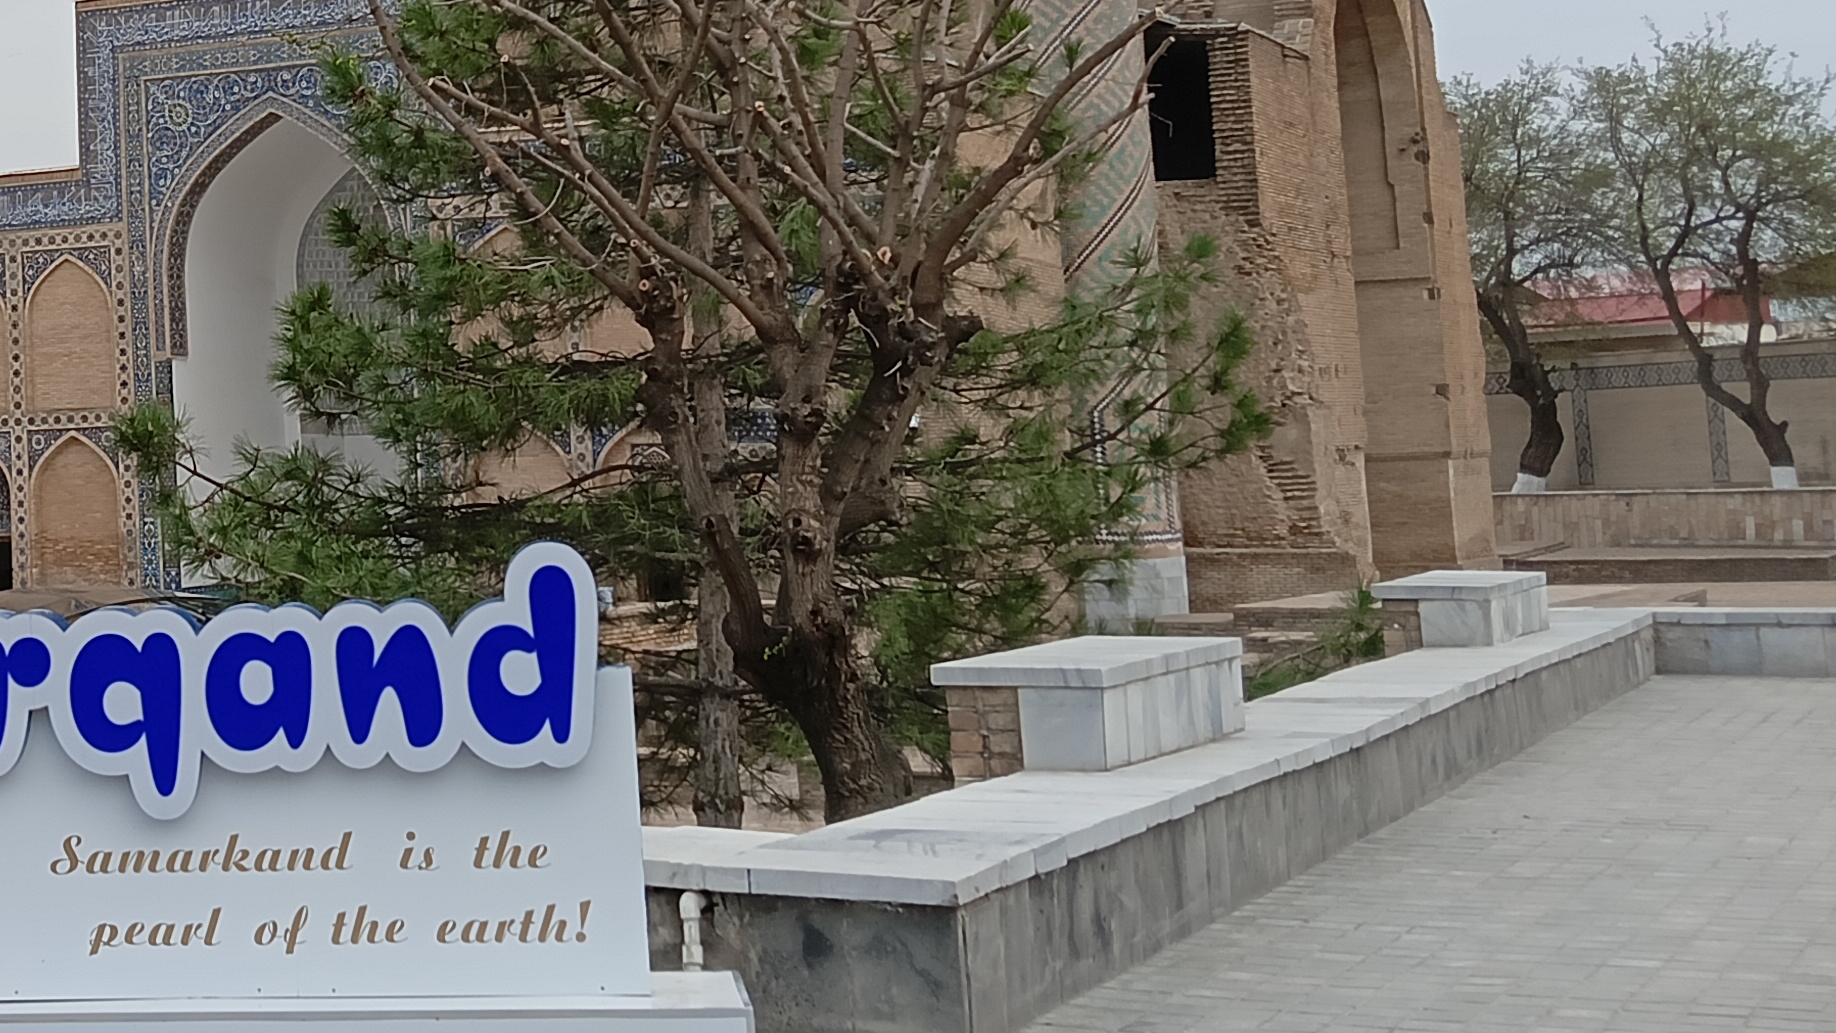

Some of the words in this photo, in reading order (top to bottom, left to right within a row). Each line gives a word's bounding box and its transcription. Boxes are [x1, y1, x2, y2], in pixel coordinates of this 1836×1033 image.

[50, 830, 353, 875] Samarkand
[399, 831, 439, 871] is
[473, 830, 550, 870] the
[89, 908, 222, 956] pearl
[253, 907, 310, 955] of
[331, 906, 407, 946] the
[436, 900, 592, 945] earth!
